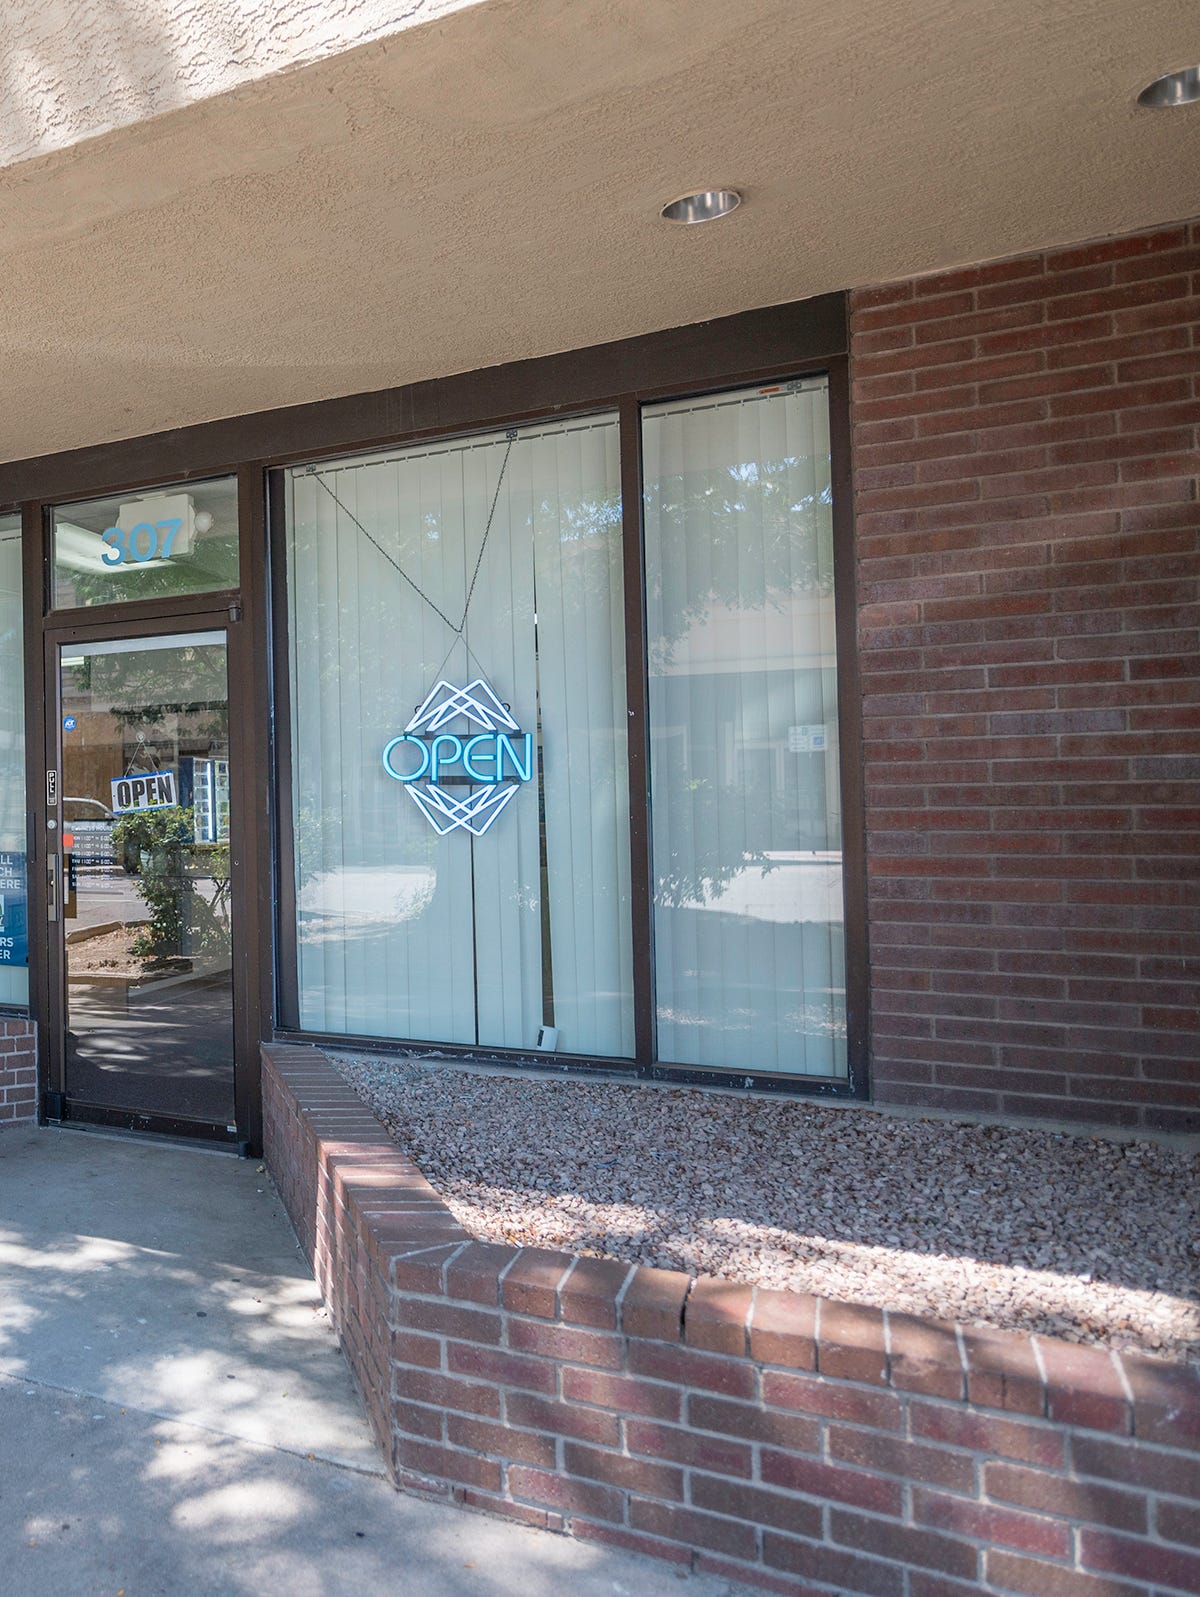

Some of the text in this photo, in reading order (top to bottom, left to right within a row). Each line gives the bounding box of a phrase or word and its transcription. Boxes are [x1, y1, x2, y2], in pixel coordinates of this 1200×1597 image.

[101, 517, 182, 566] 307
[382, 733, 533, 782] OPEN
[117, 775, 173, 808] OPEN
